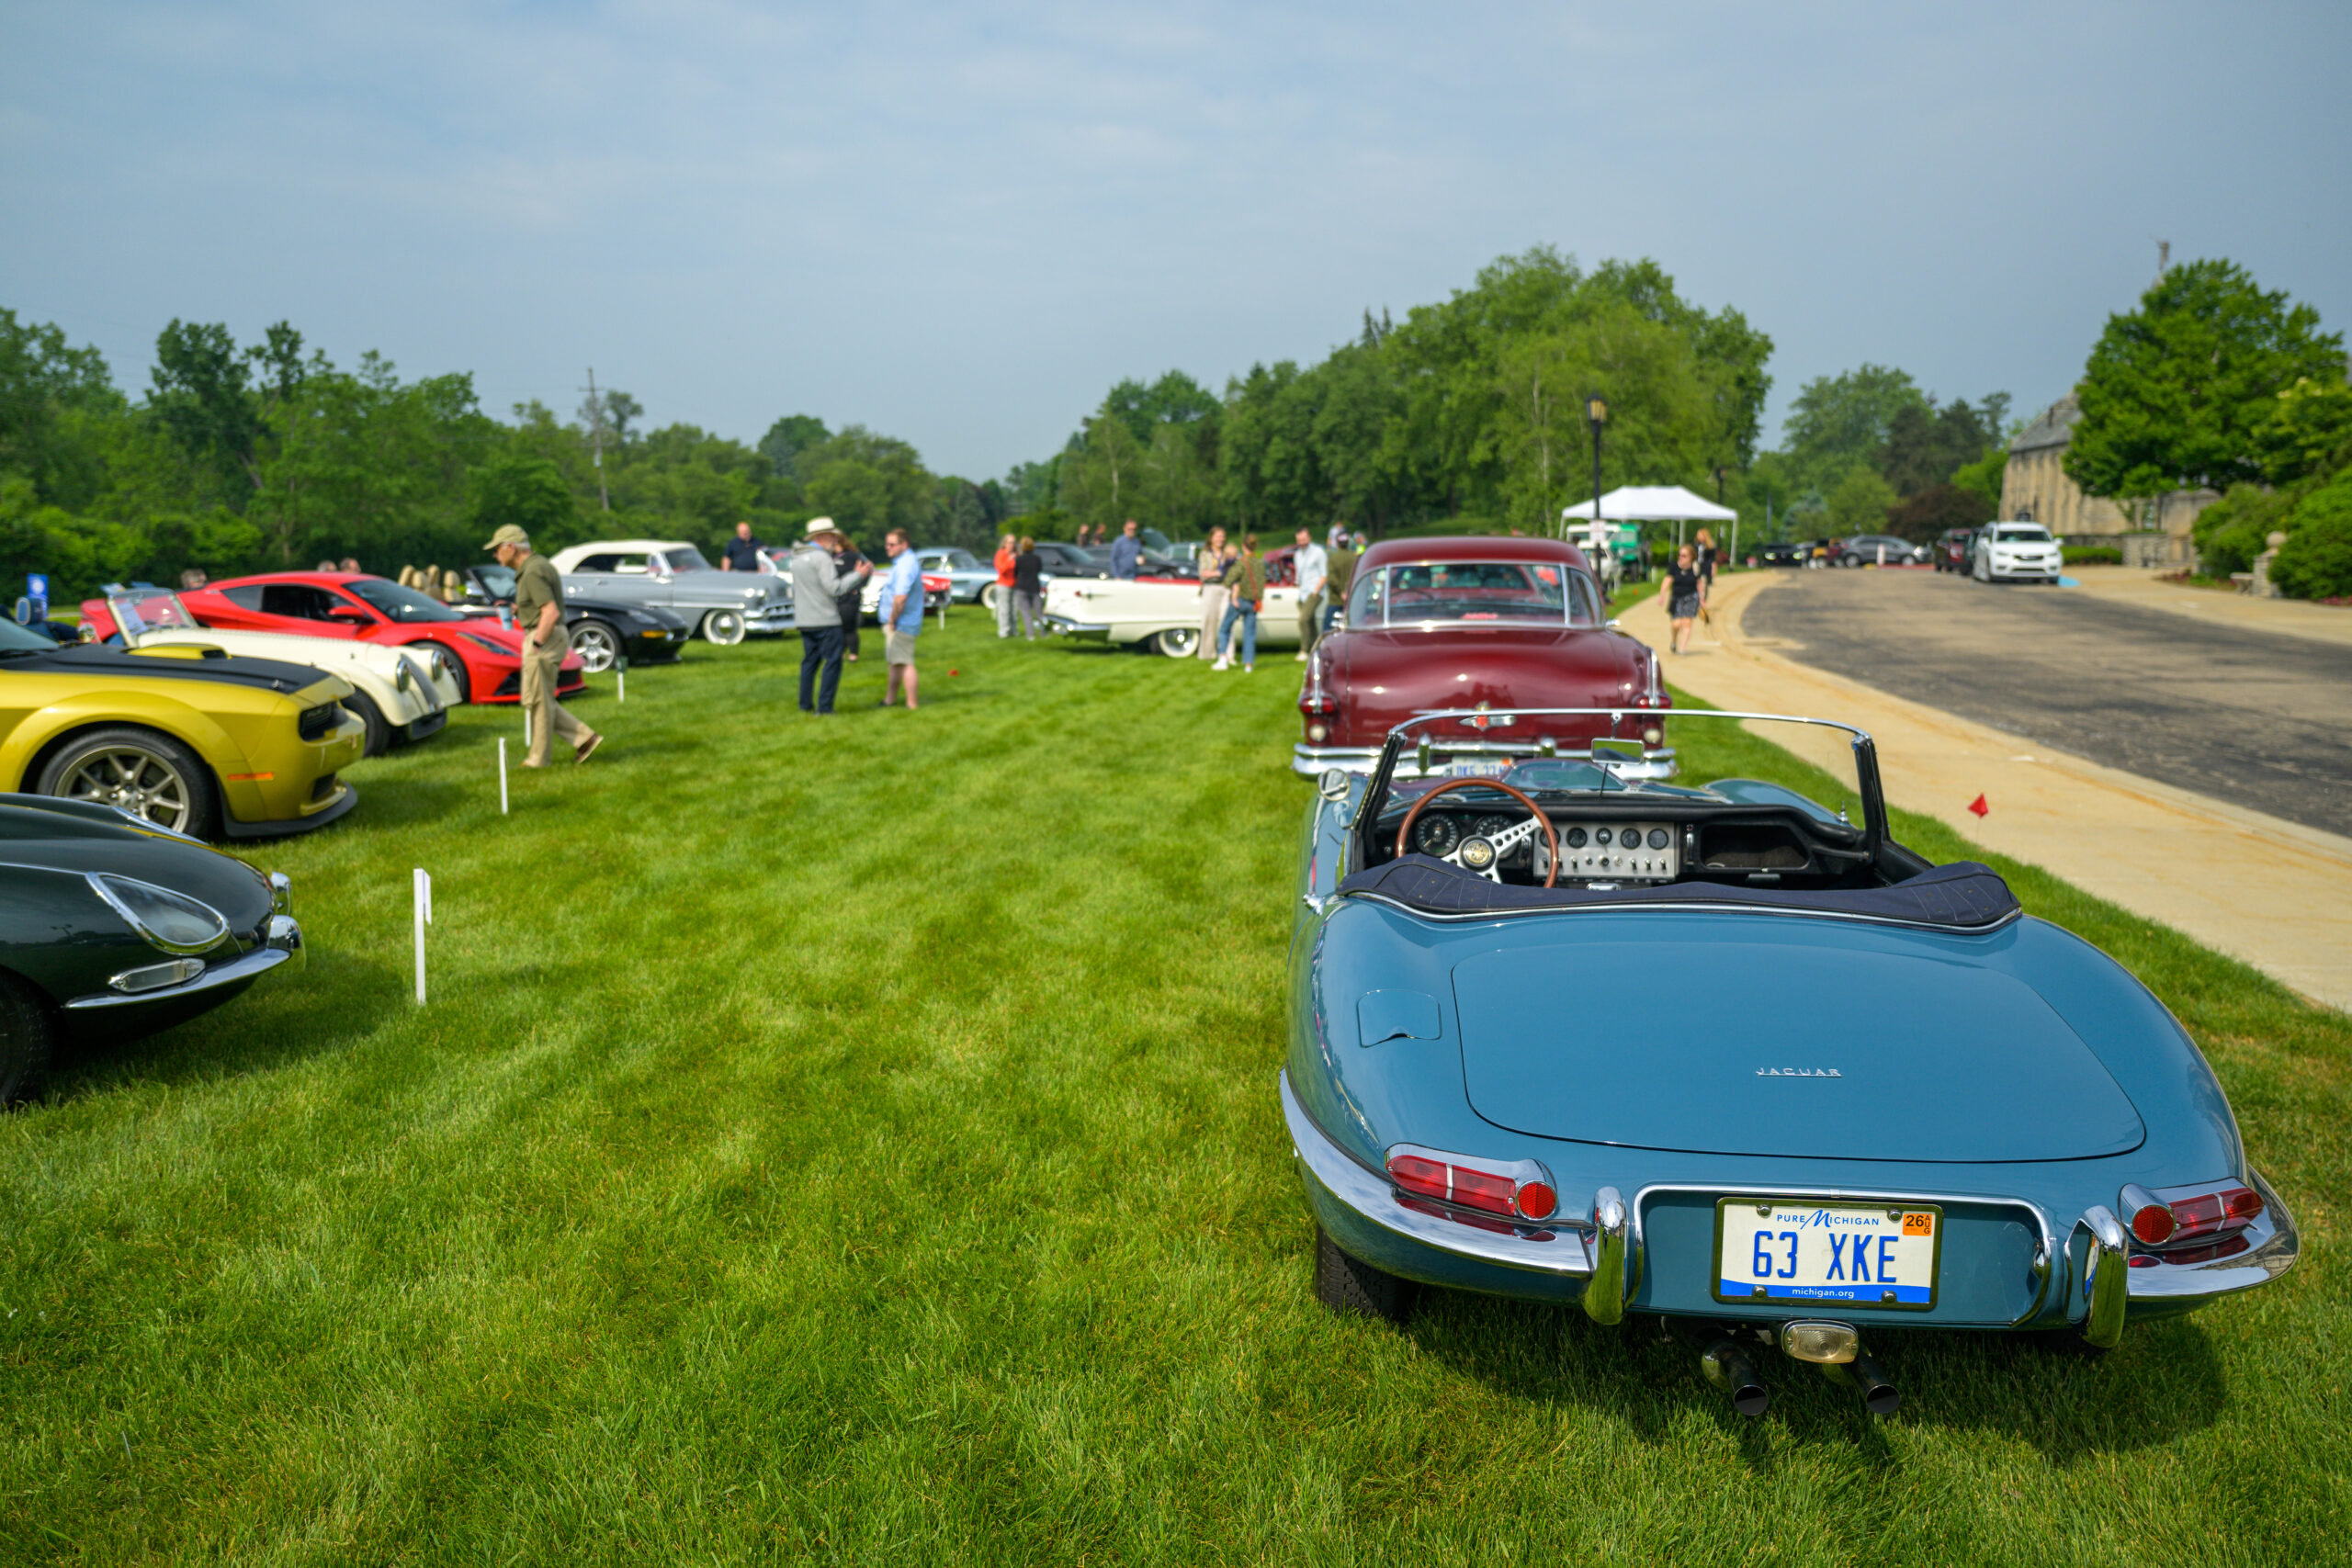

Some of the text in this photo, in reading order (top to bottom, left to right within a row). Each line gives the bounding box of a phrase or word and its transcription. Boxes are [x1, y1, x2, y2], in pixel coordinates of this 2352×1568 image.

[1756, 1067, 1842, 1077] JAGUAR
[1777, 1209, 1879, 1230] PURE MICHIGAN
[1905, 1214, 1924, 1227] 26
[1753, 1230, 1899, 1283] 63 XKE
[1792, 1288, 1854, 1299] michigan.org
